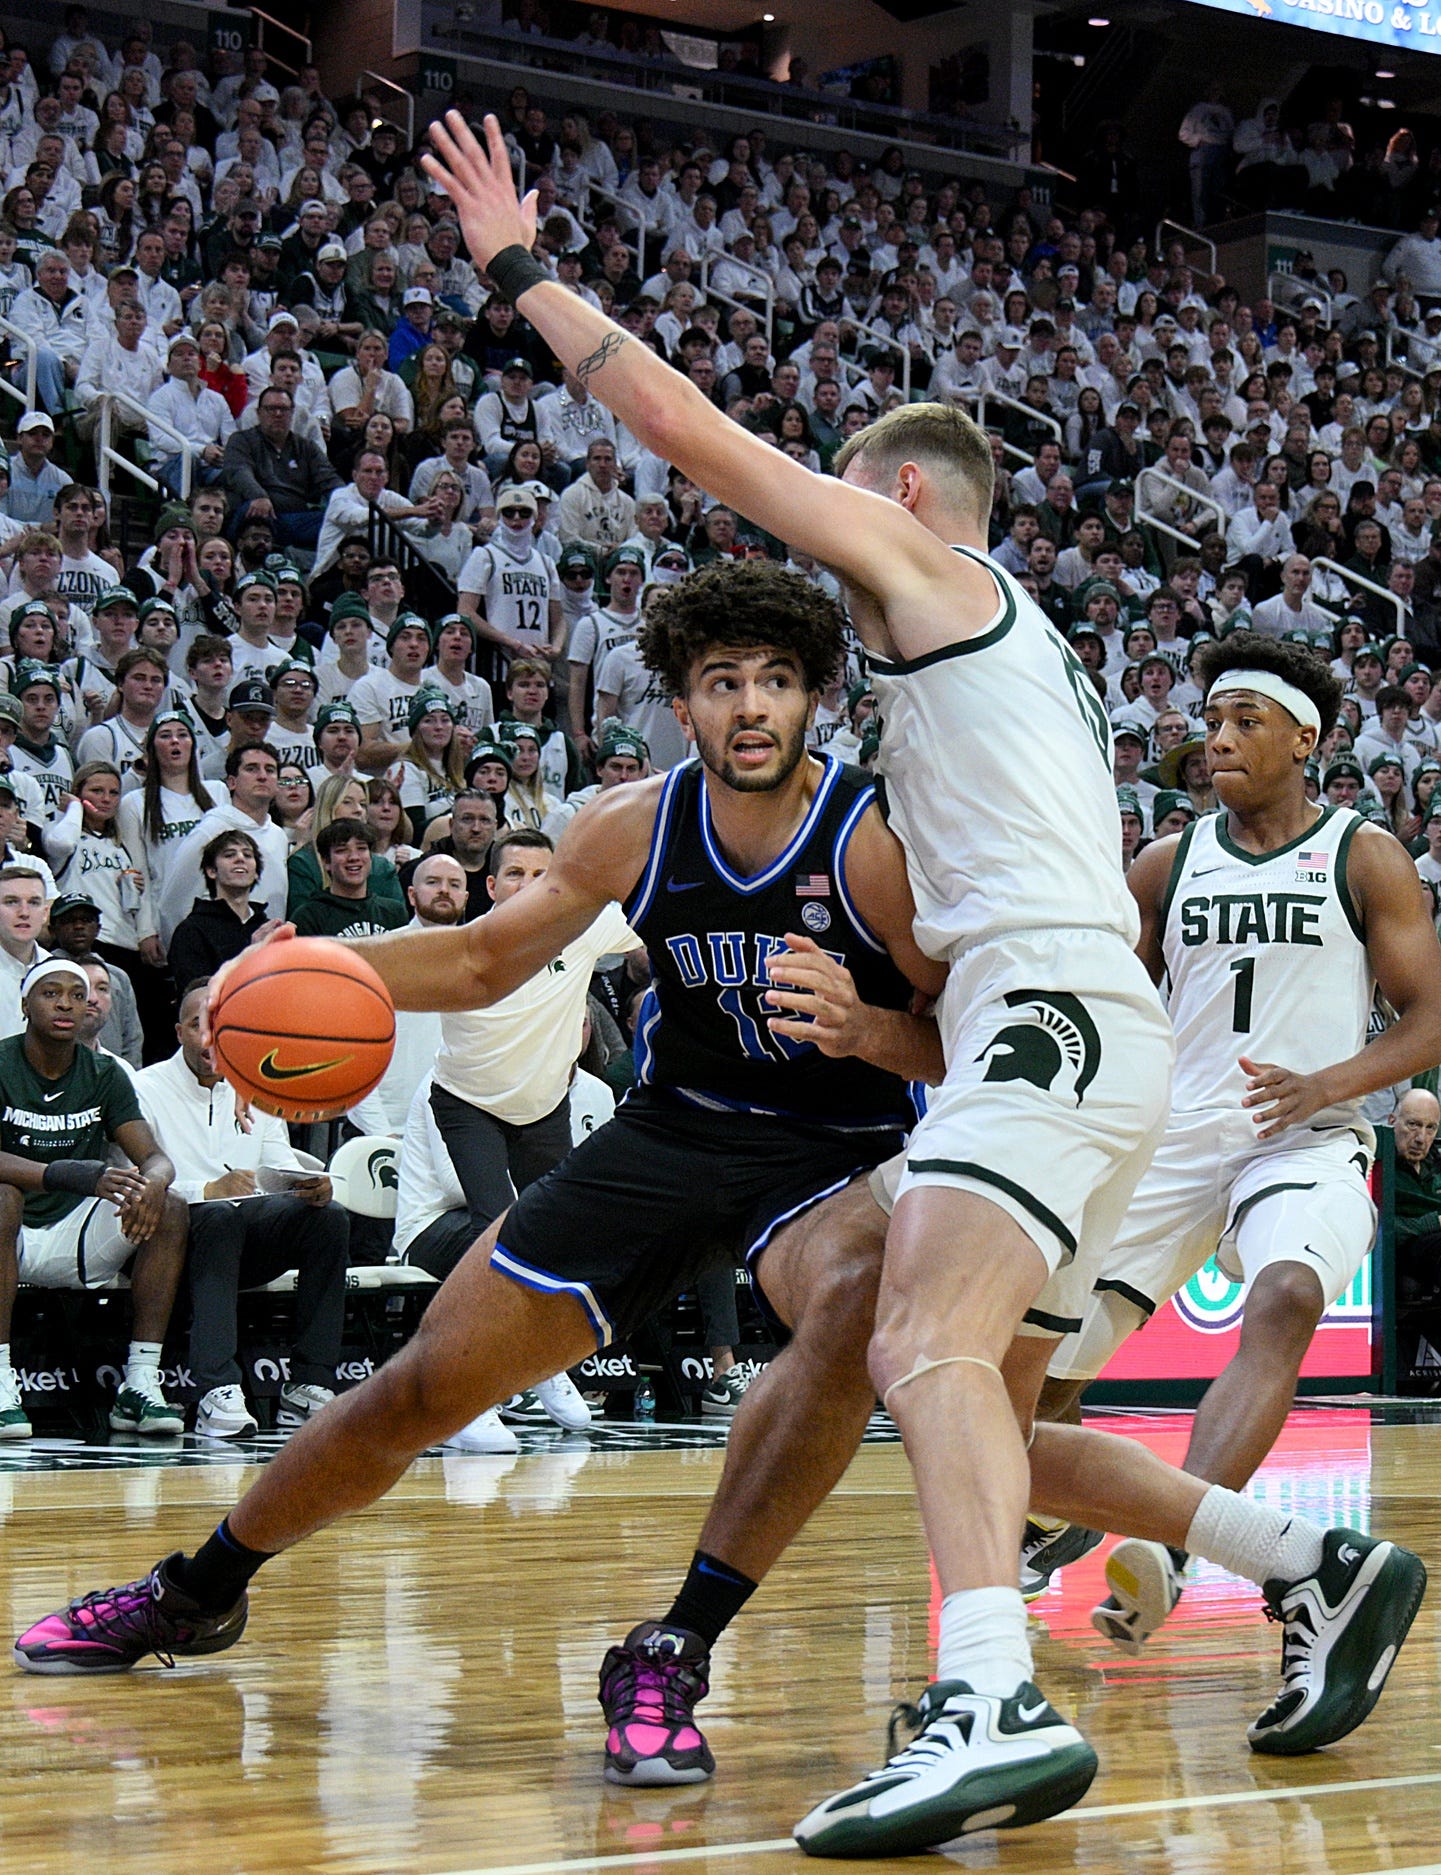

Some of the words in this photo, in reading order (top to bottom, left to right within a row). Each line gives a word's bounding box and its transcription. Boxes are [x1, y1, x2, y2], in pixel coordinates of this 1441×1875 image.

[1391, 6, 1412, 31] &
[1419, 11, 1441, 36] L
[215, 29, 242, 50] 110
[424, 69, 453, 90] 110
[502, 573, 547, 598] STATE
[515, 599, 541, 630] 12
[1181, 893, 1327, 947] STATE
[665, 931, 846, 988] DUK
[1229, 957, 1256, 1034] 1
[2, 1105, 66, 1132] MICHIGAN
[66, 1105, 102, 1131] STATE
[580, 1353, 637, 1377] cket
